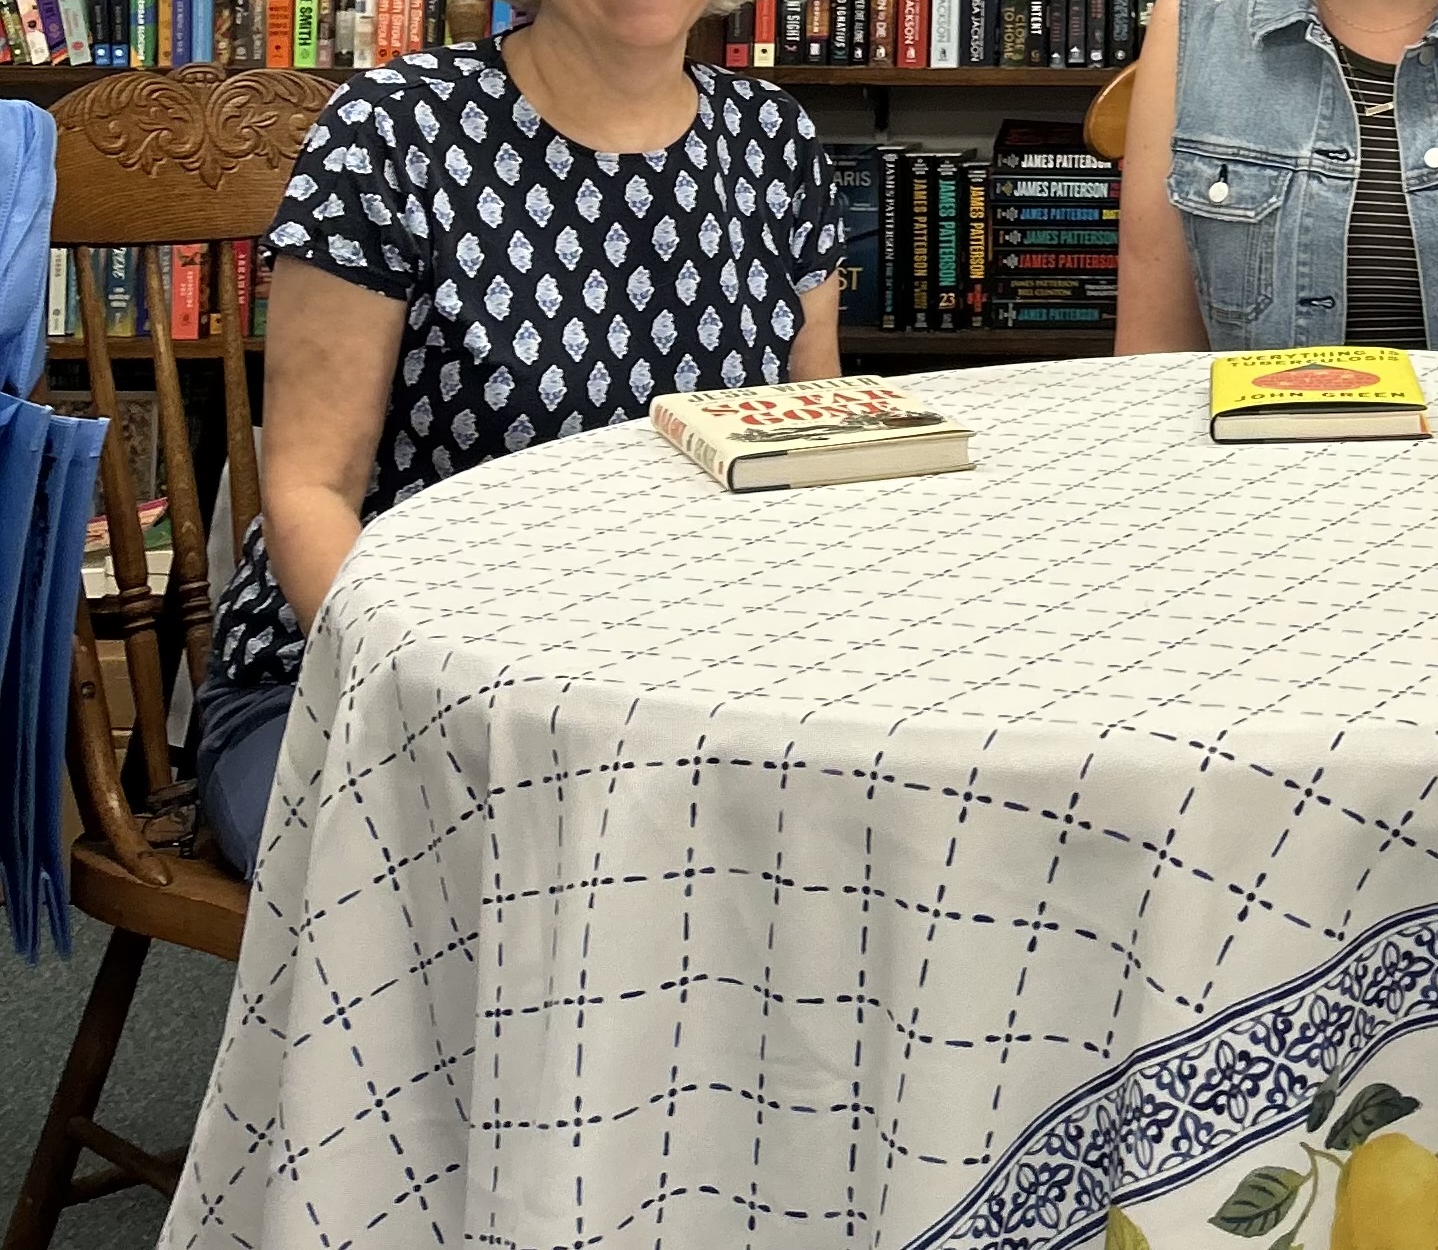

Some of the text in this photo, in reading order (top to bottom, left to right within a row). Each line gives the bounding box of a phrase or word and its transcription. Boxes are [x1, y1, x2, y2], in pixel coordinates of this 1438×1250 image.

[297, 7, 314, 46] SMITH
[939, 179, 956, 286] JAMES PATTERSON
[969, 185, 985, 279] JAMES PATTERSON
[1227, 351, 1365, 362] EVERYTHING
[688, 377, 880, 403] JESS WALTER
[701, 389, 906, 419] SO FAR
[1234, 392, 1303, 402] JOHN
[740, 401, 901, 425] GONE
